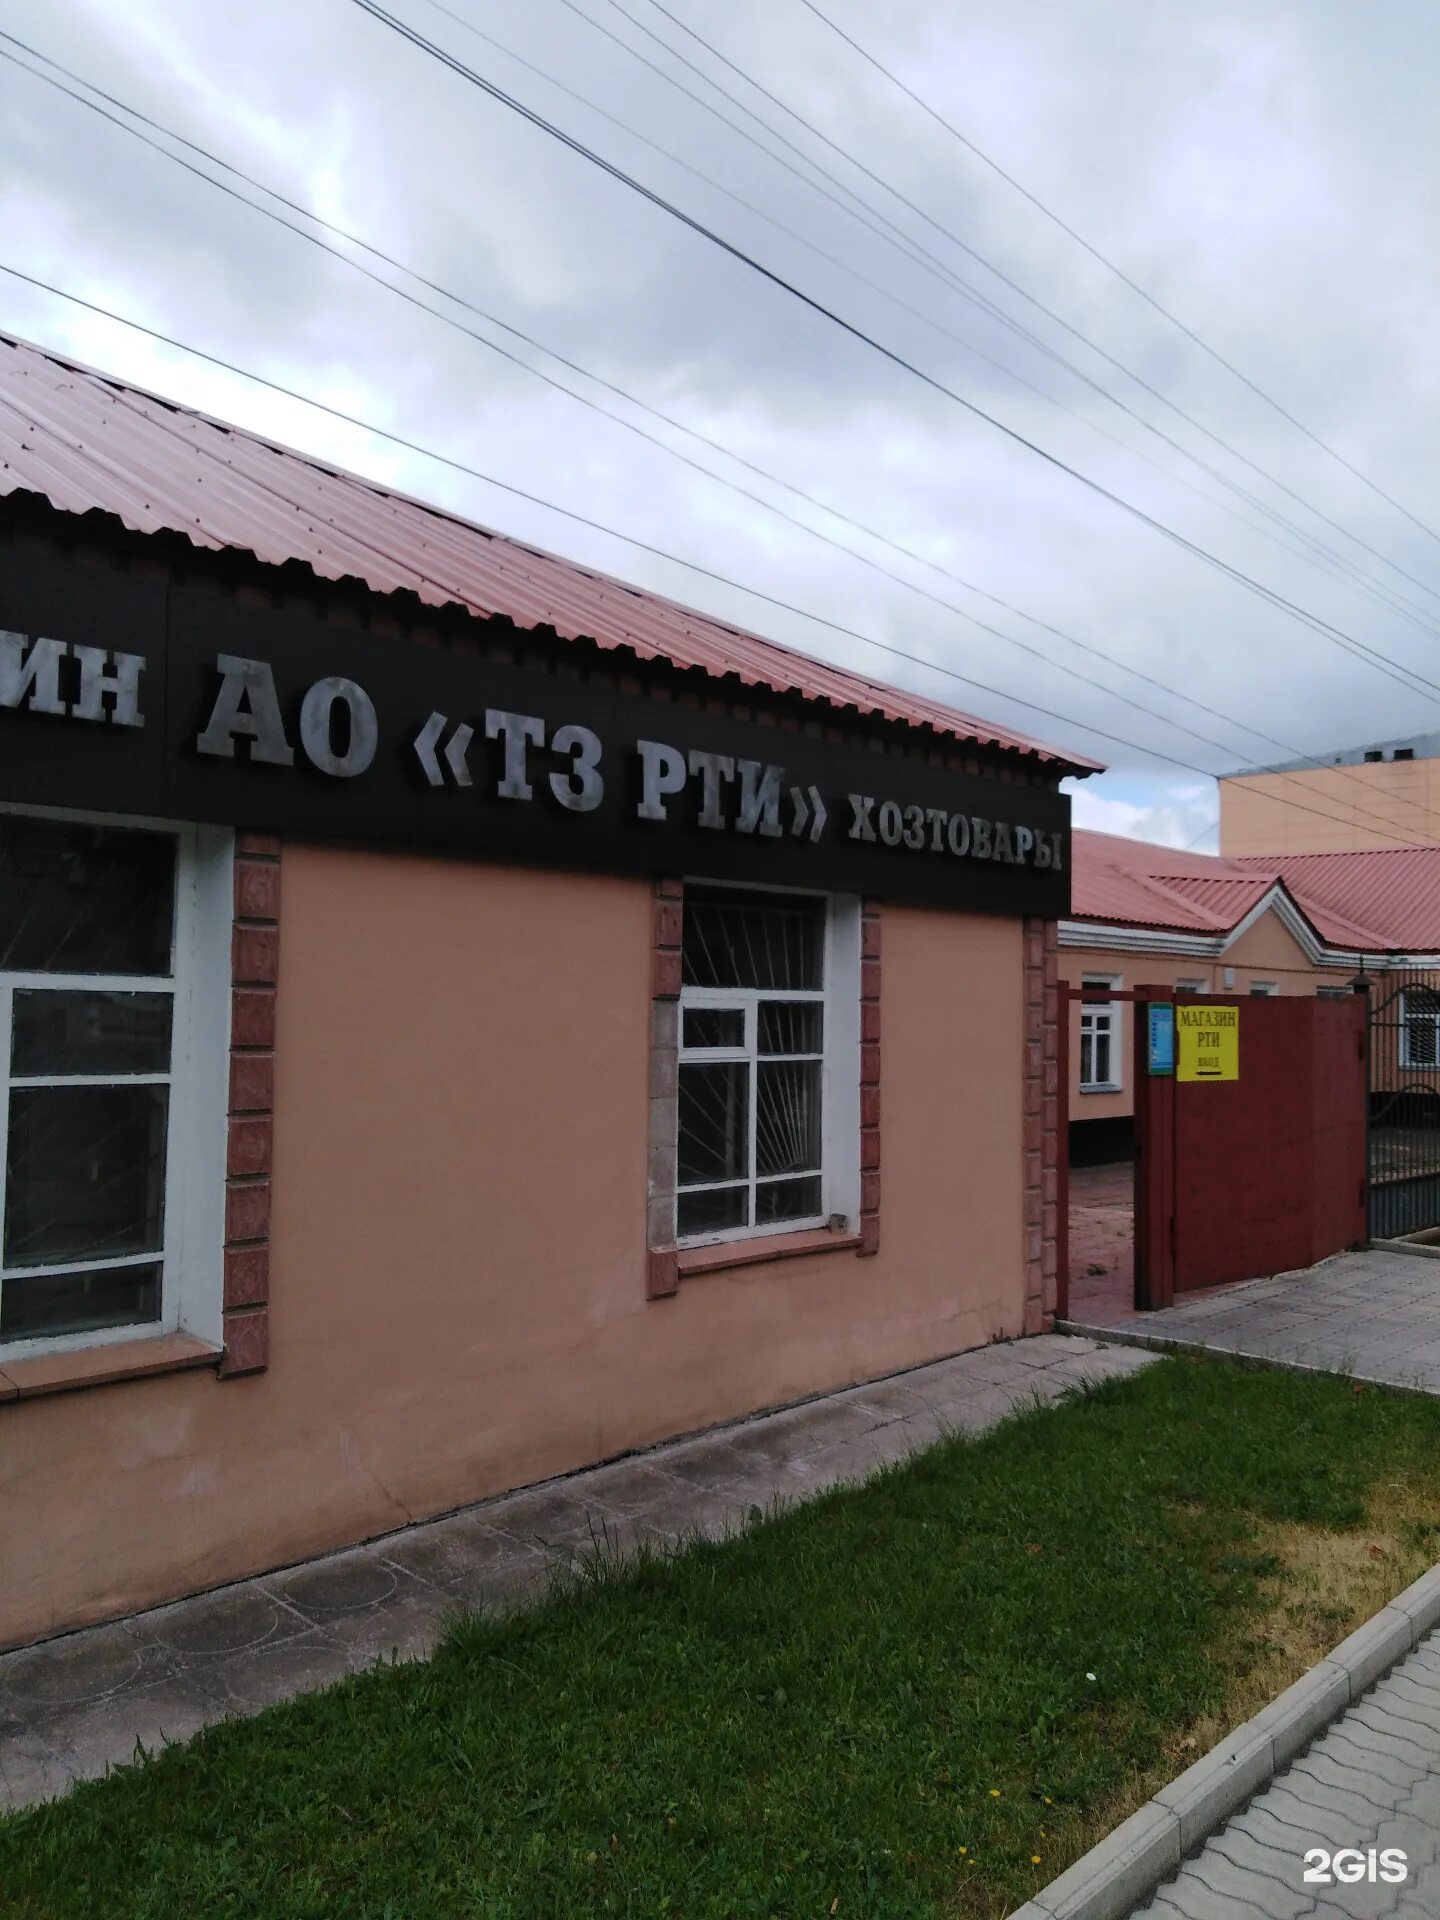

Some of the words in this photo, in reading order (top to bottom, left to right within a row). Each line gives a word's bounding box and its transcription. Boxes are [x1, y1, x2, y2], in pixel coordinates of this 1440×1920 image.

[197, 653, 378, 777] АО
[413, 708, 604, 812] «ТЗ
[637, 740, 827, 843] РТИ»
[848, 794, 1063, 870] ХОЗТОВАРЫ
[1181, 1011, 1236, 1027] МАГАЗИН
[1197, 1032, 1220, 1047] РТИ
